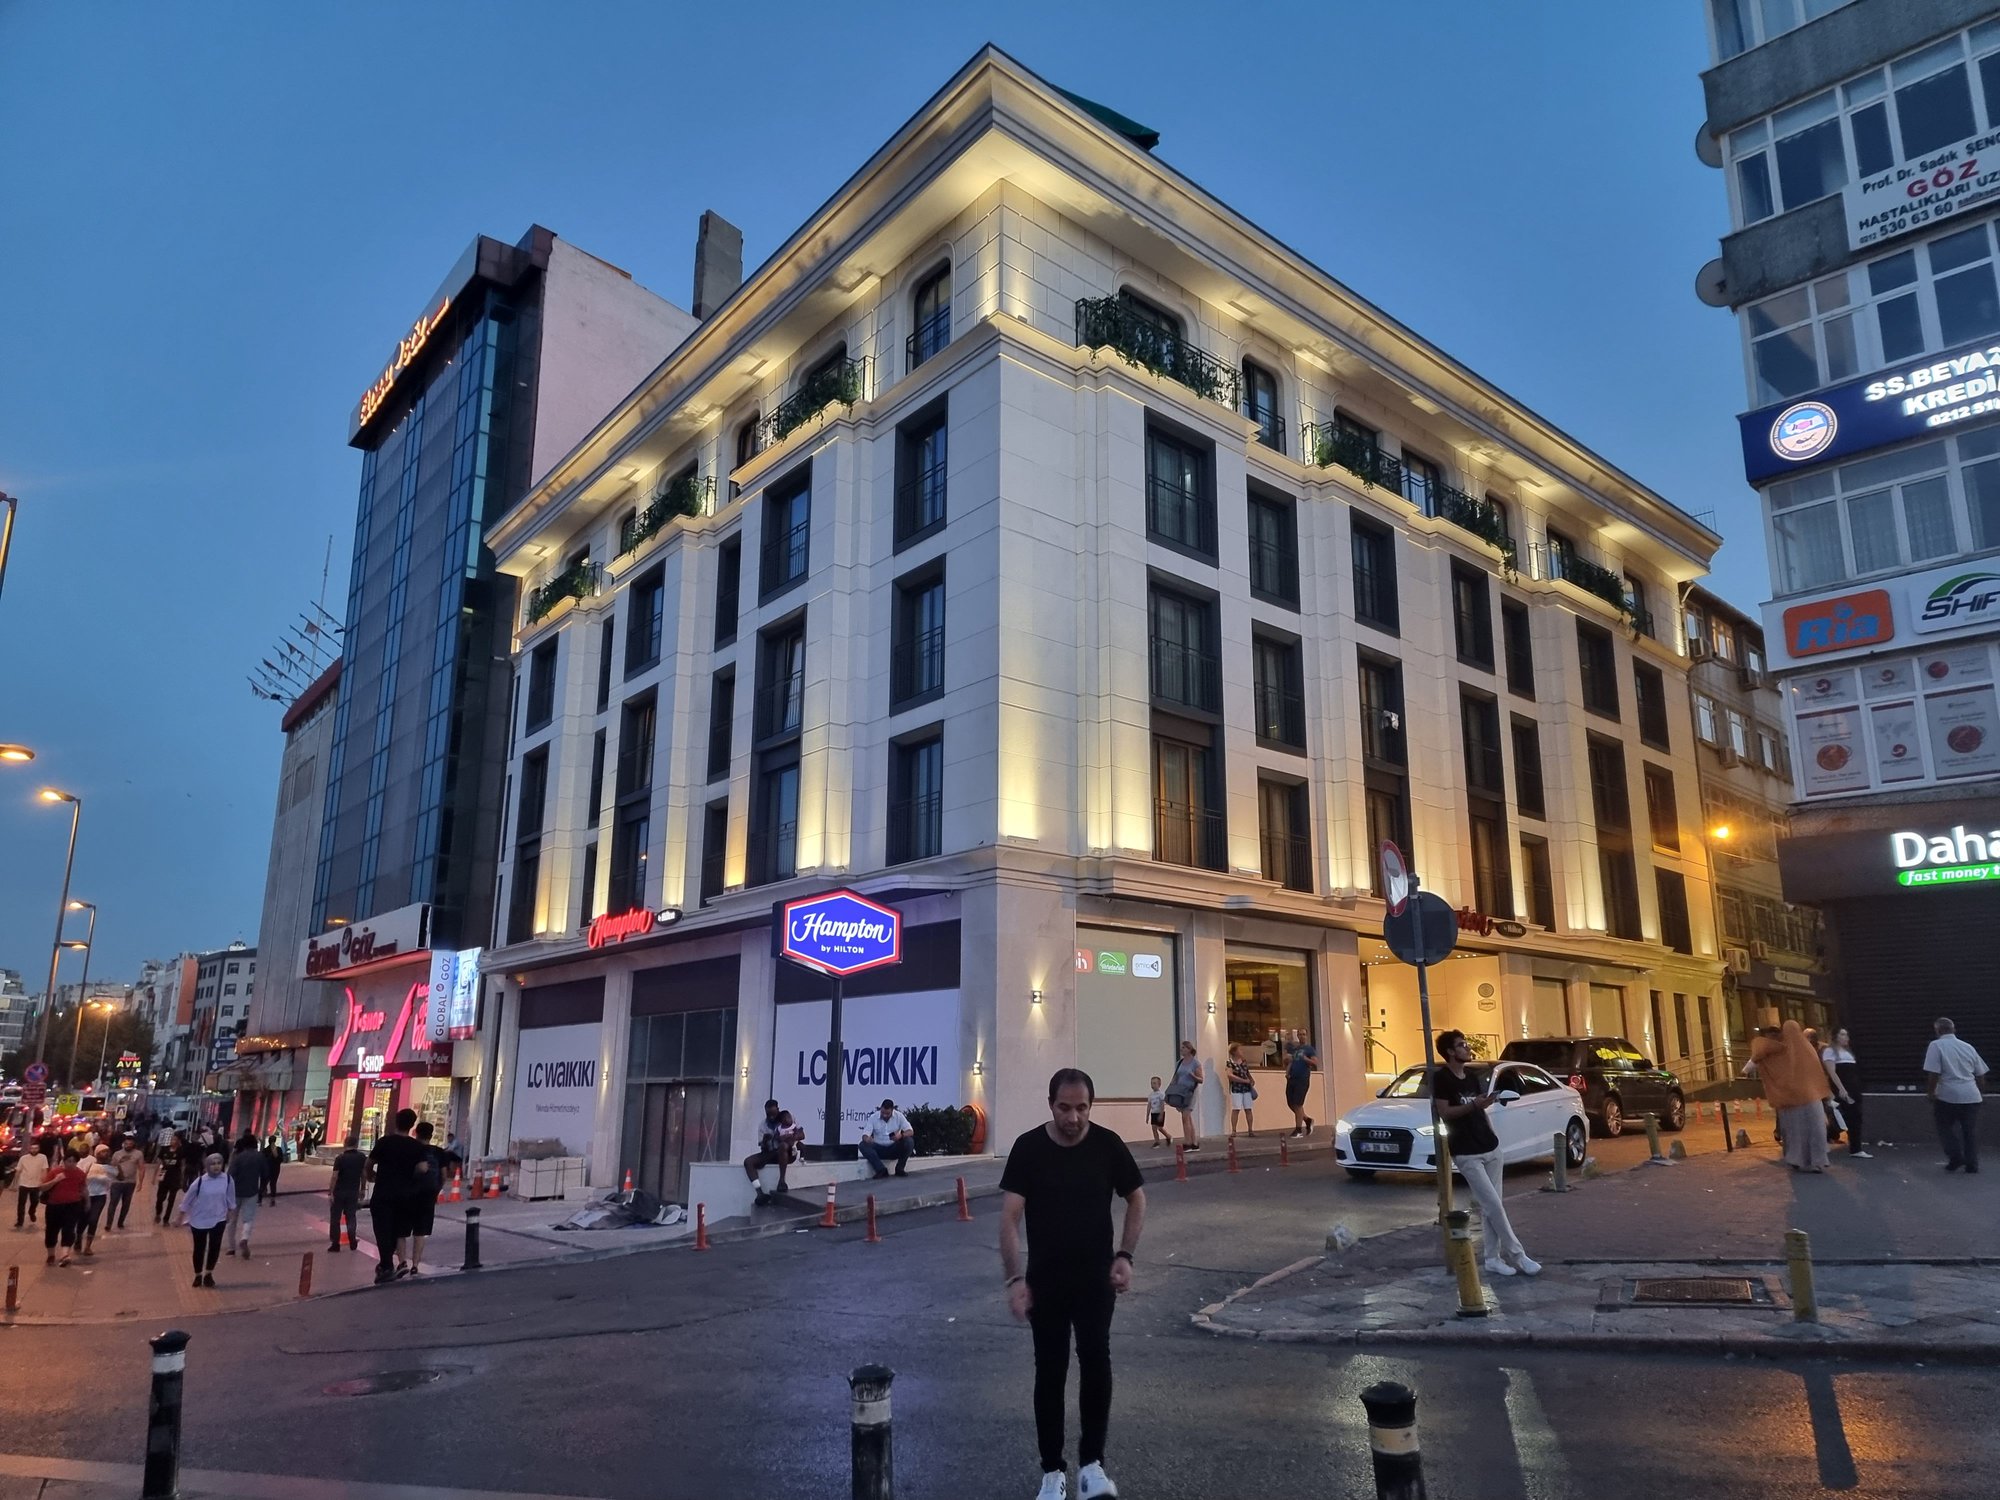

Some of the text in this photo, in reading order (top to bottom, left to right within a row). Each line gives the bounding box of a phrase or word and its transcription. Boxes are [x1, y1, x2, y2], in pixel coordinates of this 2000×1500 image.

[1863, 174, 1893, 194] Prof.
[1897, 168, 1915, 182] Dr.
[1906, 158, 1979, 198] GÖZ
[1859, 181, 1971, 230] HASTALIKLARI
[1880, 218, 1907, 237] 530
[1911, 209, 1930, 225] 63
[1934, 201, 1953, 216] 60
[1901, 369, 2000, 417] KREDİ
[1926, 406, 1971, 427] 0212
[1796, 602, 1879, 651] Ria
[1906, 870, 1938, 885] fast
[1942, 866, 1990, 879] money
[791, 912, 893, 944] Hampton
[820, 945, 865, 954] by HILTON
[435, 957, 451, 1036] GLOBAL GÖZ
[797, 1049, 828, 1086] LC
